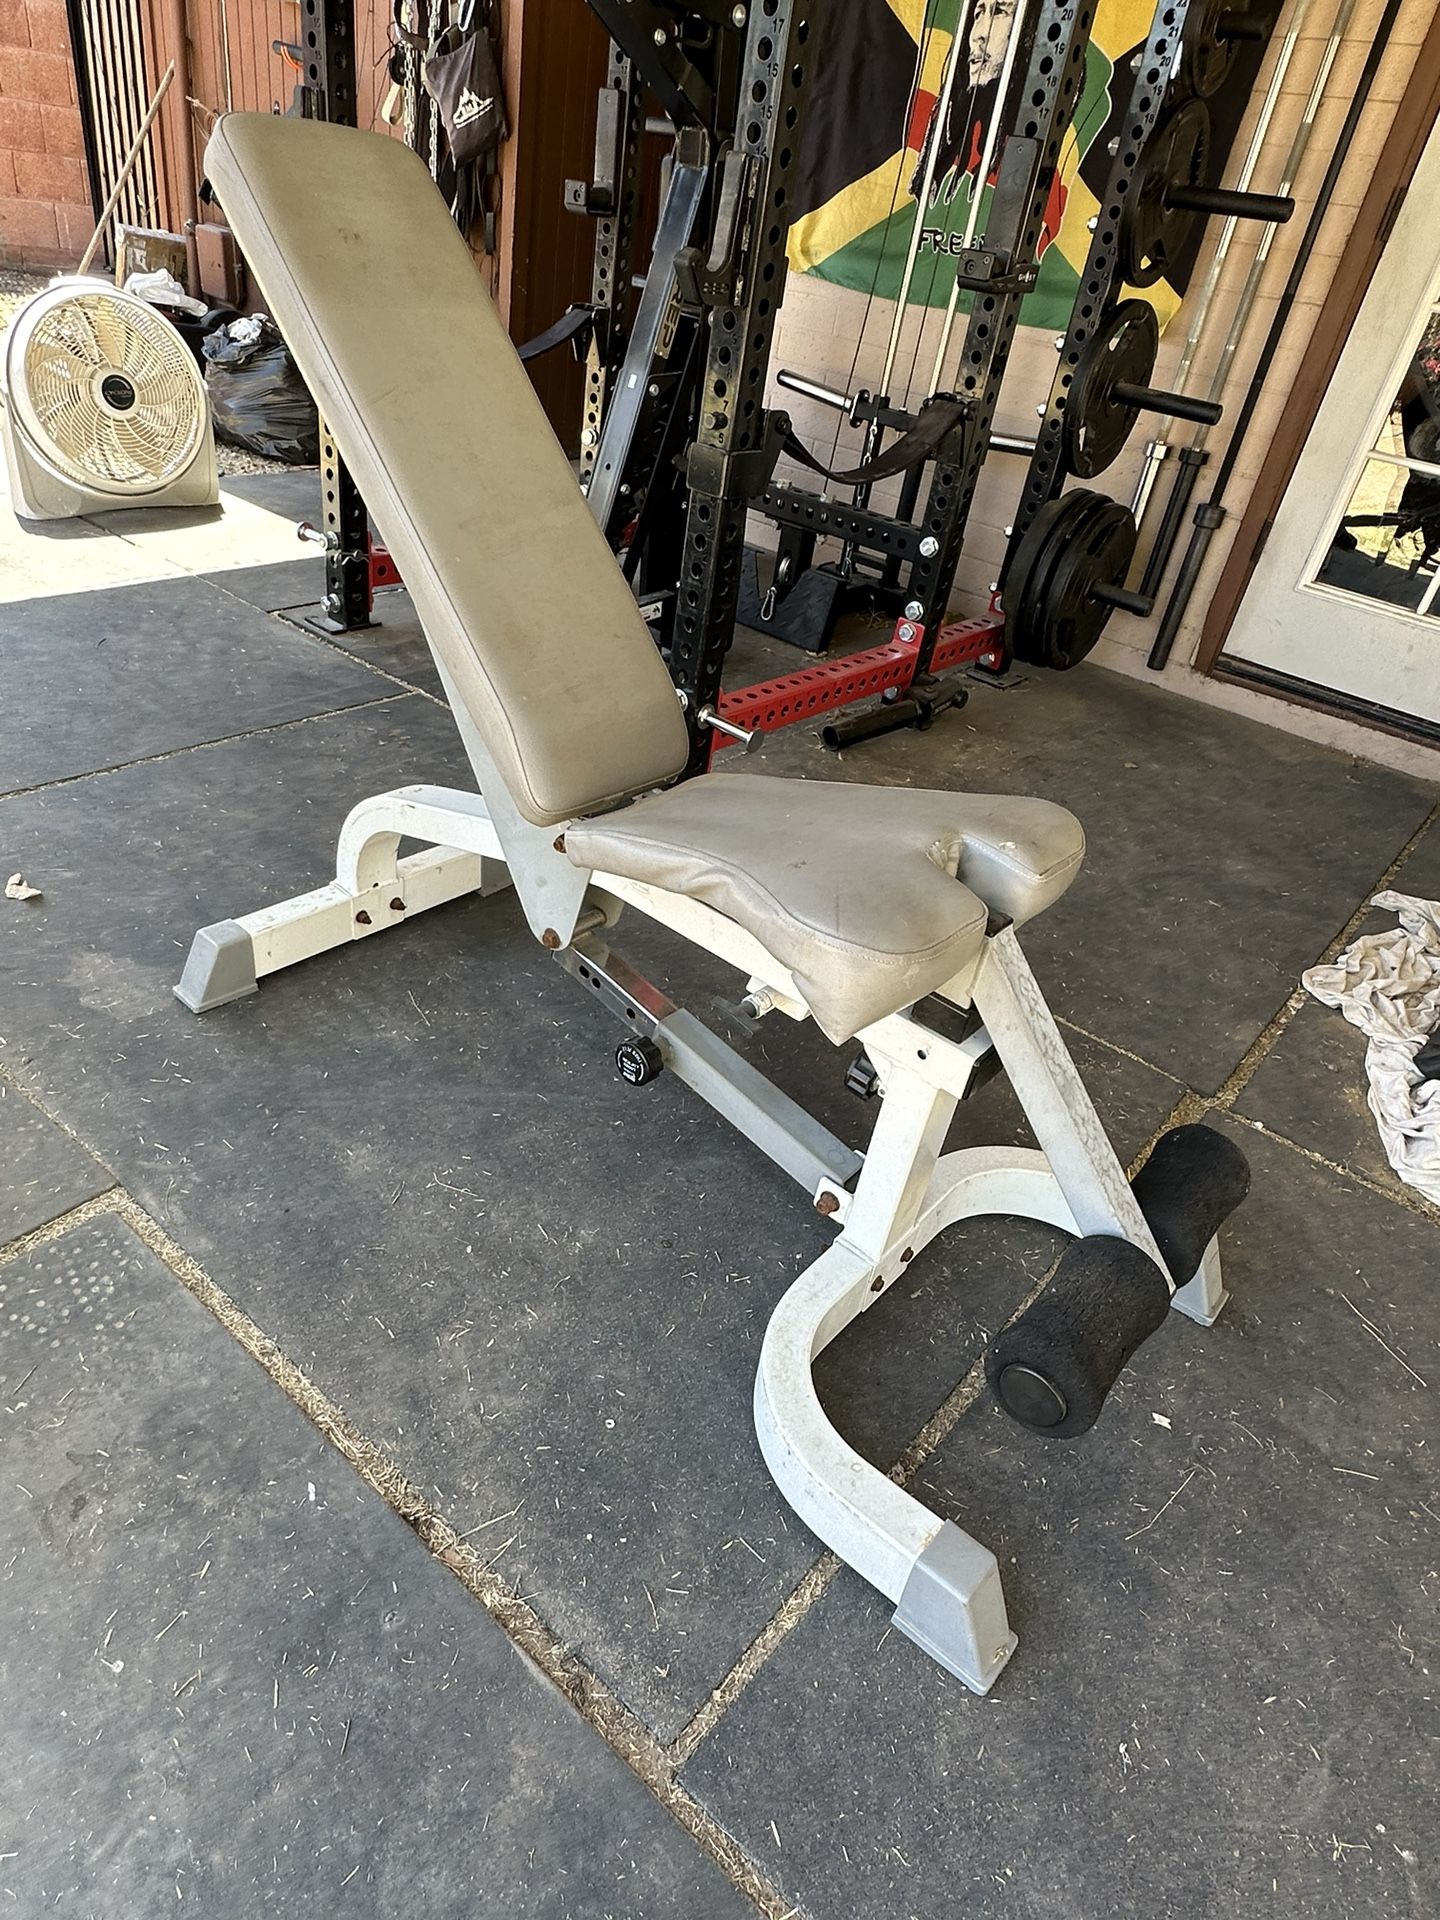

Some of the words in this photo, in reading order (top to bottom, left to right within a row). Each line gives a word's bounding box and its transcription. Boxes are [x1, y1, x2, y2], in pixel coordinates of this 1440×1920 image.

[1061, 9, 1073, 20] 20
[773, 18, 785, 33] 17
[1168, 26, 1179, 37] 21
[1054, 42, 1066, 54] 19
[1160, 56, 1171, 67] 20
[1047, 76, 1057, 87] 18
[1153, 85, 1162, 95] 19
[761, 105, 773, 120] 15
[1039, 107, 1049, 119] 17
[1145, 113, 1154, 123] 18
[723, 400, 729, 412] 7
